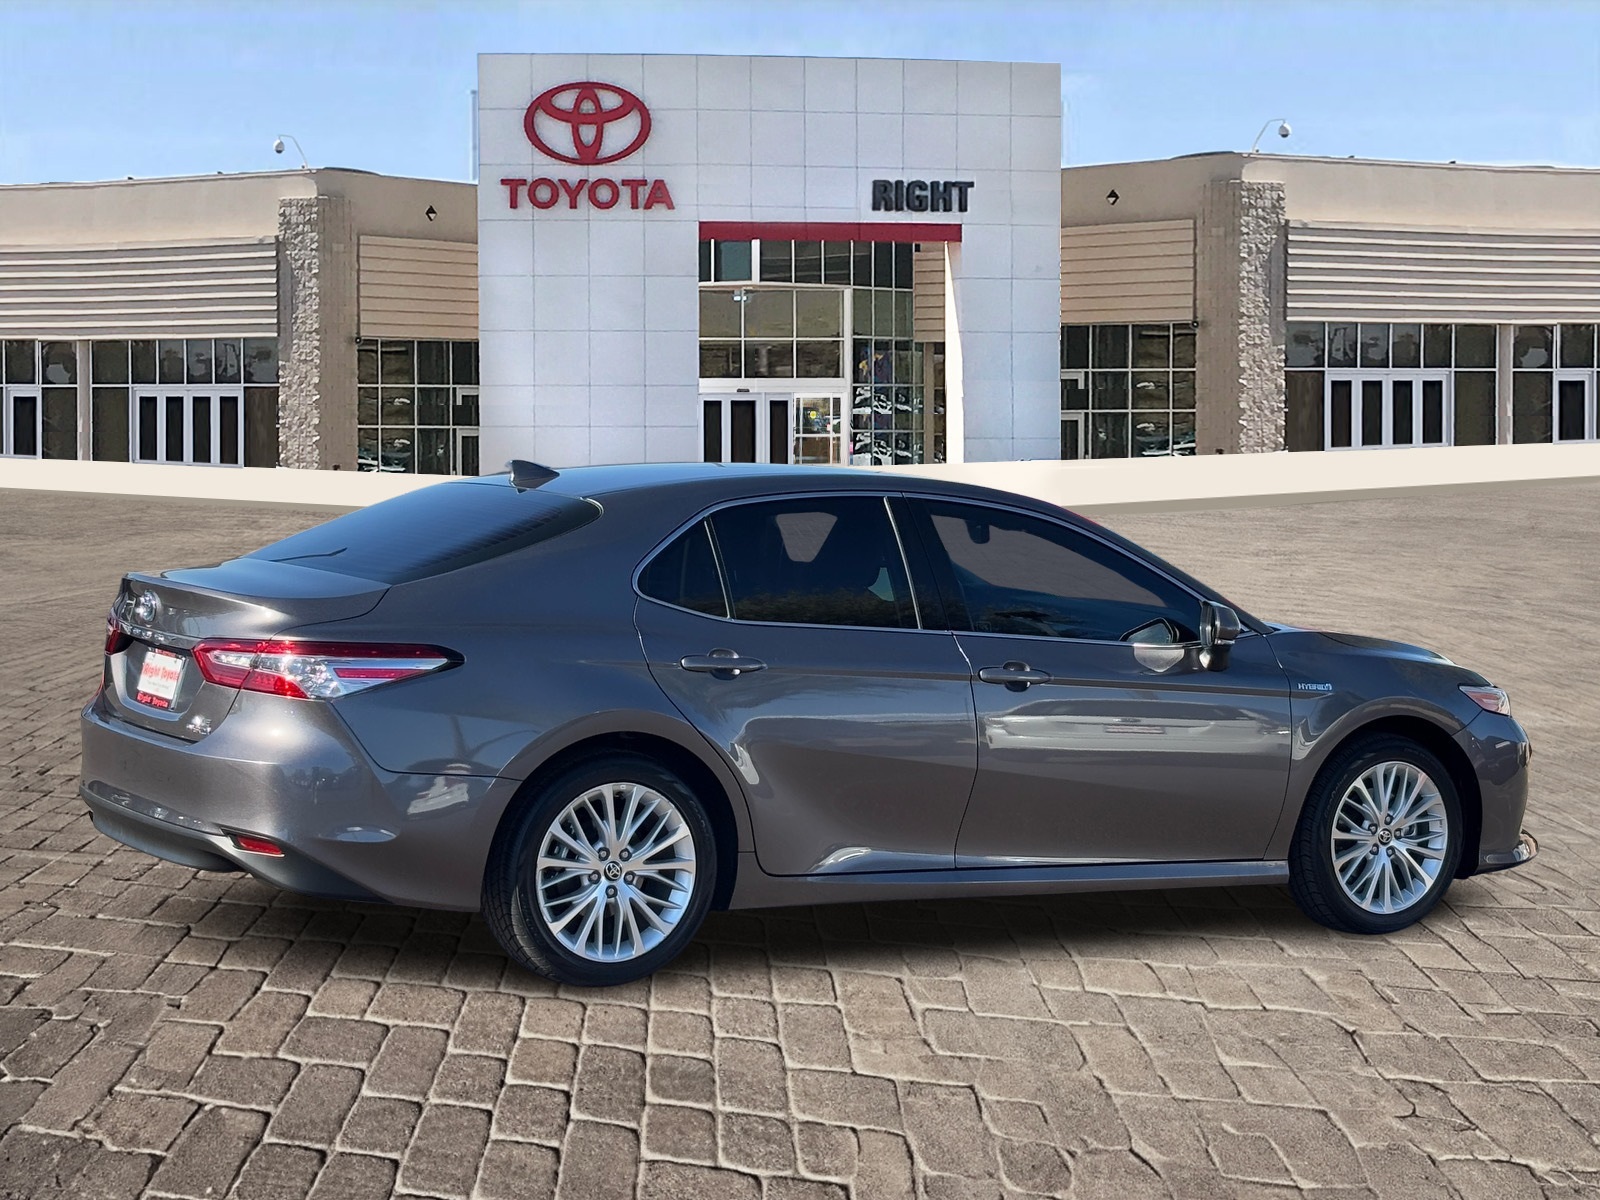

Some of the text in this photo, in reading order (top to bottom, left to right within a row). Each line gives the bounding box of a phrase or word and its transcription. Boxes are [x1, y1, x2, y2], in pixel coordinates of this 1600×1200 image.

[500, 178, 675, 210] TOYOTA
[872, 179, 975, 212] RIGHT
[143, 662, 179, 682] Right Toyota
[1297, 682, 1328, 690] HYBRID
[137, 692, 169, 708] Right Toyota
